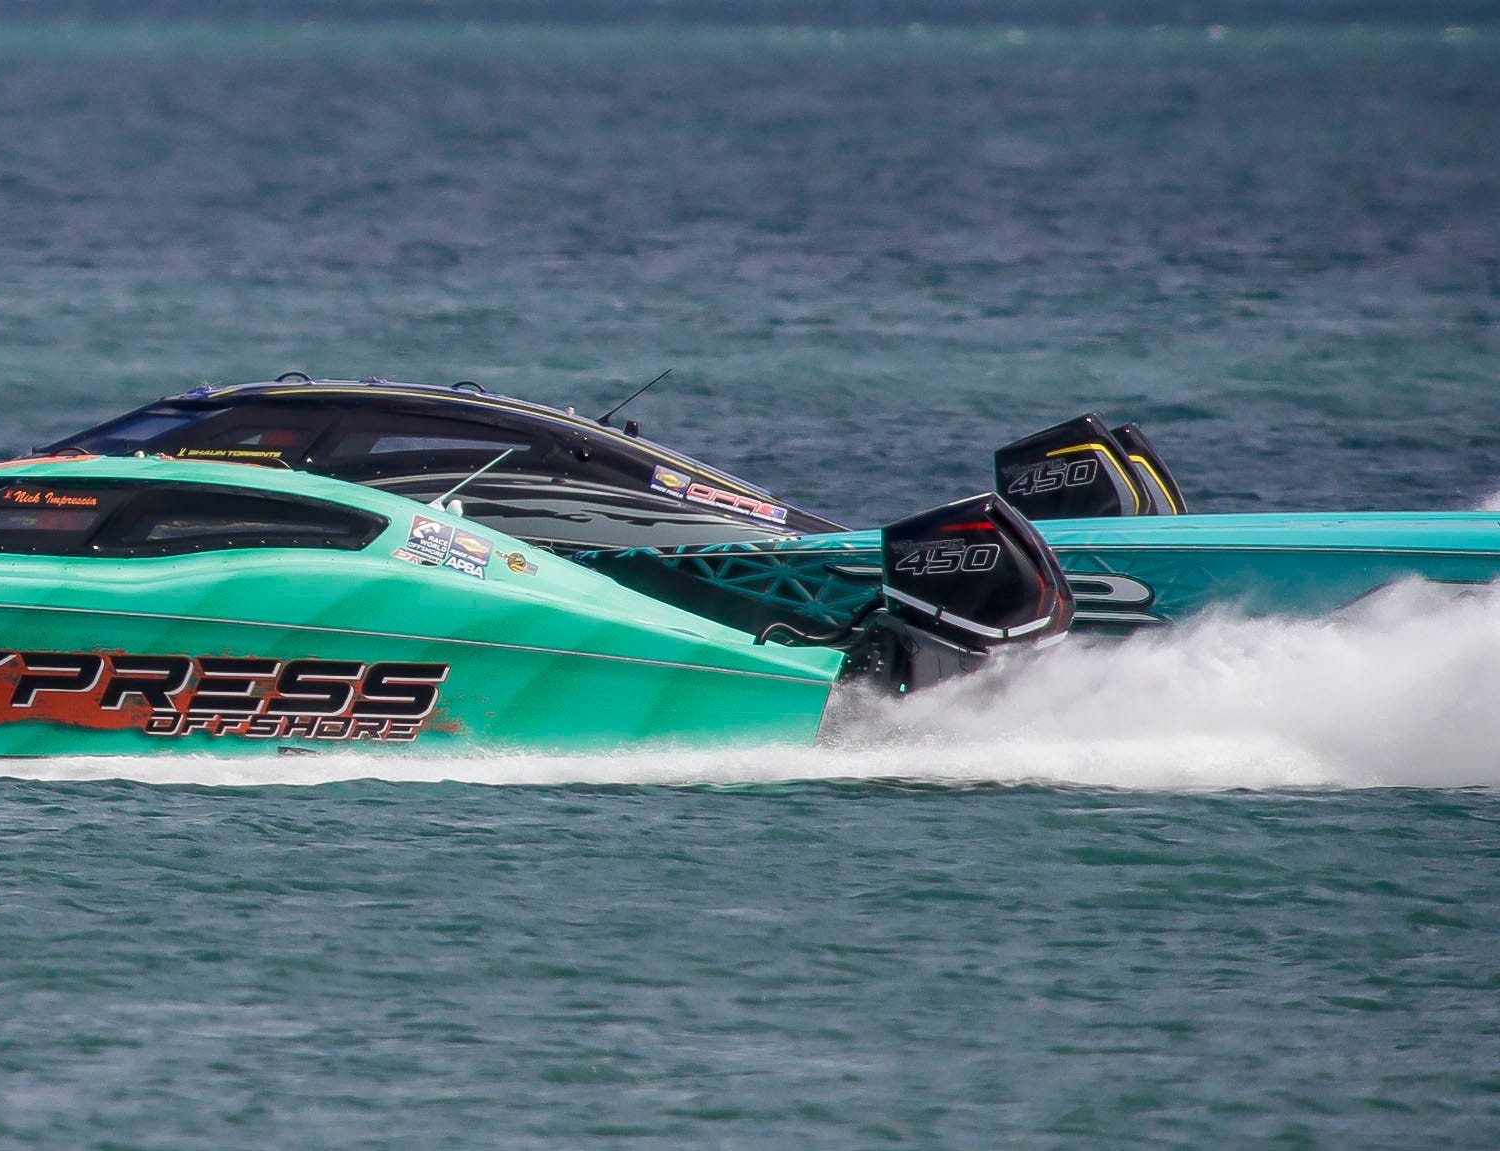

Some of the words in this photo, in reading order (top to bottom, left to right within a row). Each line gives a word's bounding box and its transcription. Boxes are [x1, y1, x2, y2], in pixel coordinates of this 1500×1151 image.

[188, 449, 227, 457] SHAUN
[228, 450, 282, 458] TORRENTE
[1007, 459, 1098, 496] 450
[13, 490, 41, 503] Nick
[406, 541, 446, 559] OFFSHORE
[419, 538, 448, 553] WORLD
[427, 535, 449, 547] RACE
[445, 555, 484, 580] APBA
[895, 543, 1000, 576] 450
[145, 713, 424, 742] OFFSHORE
